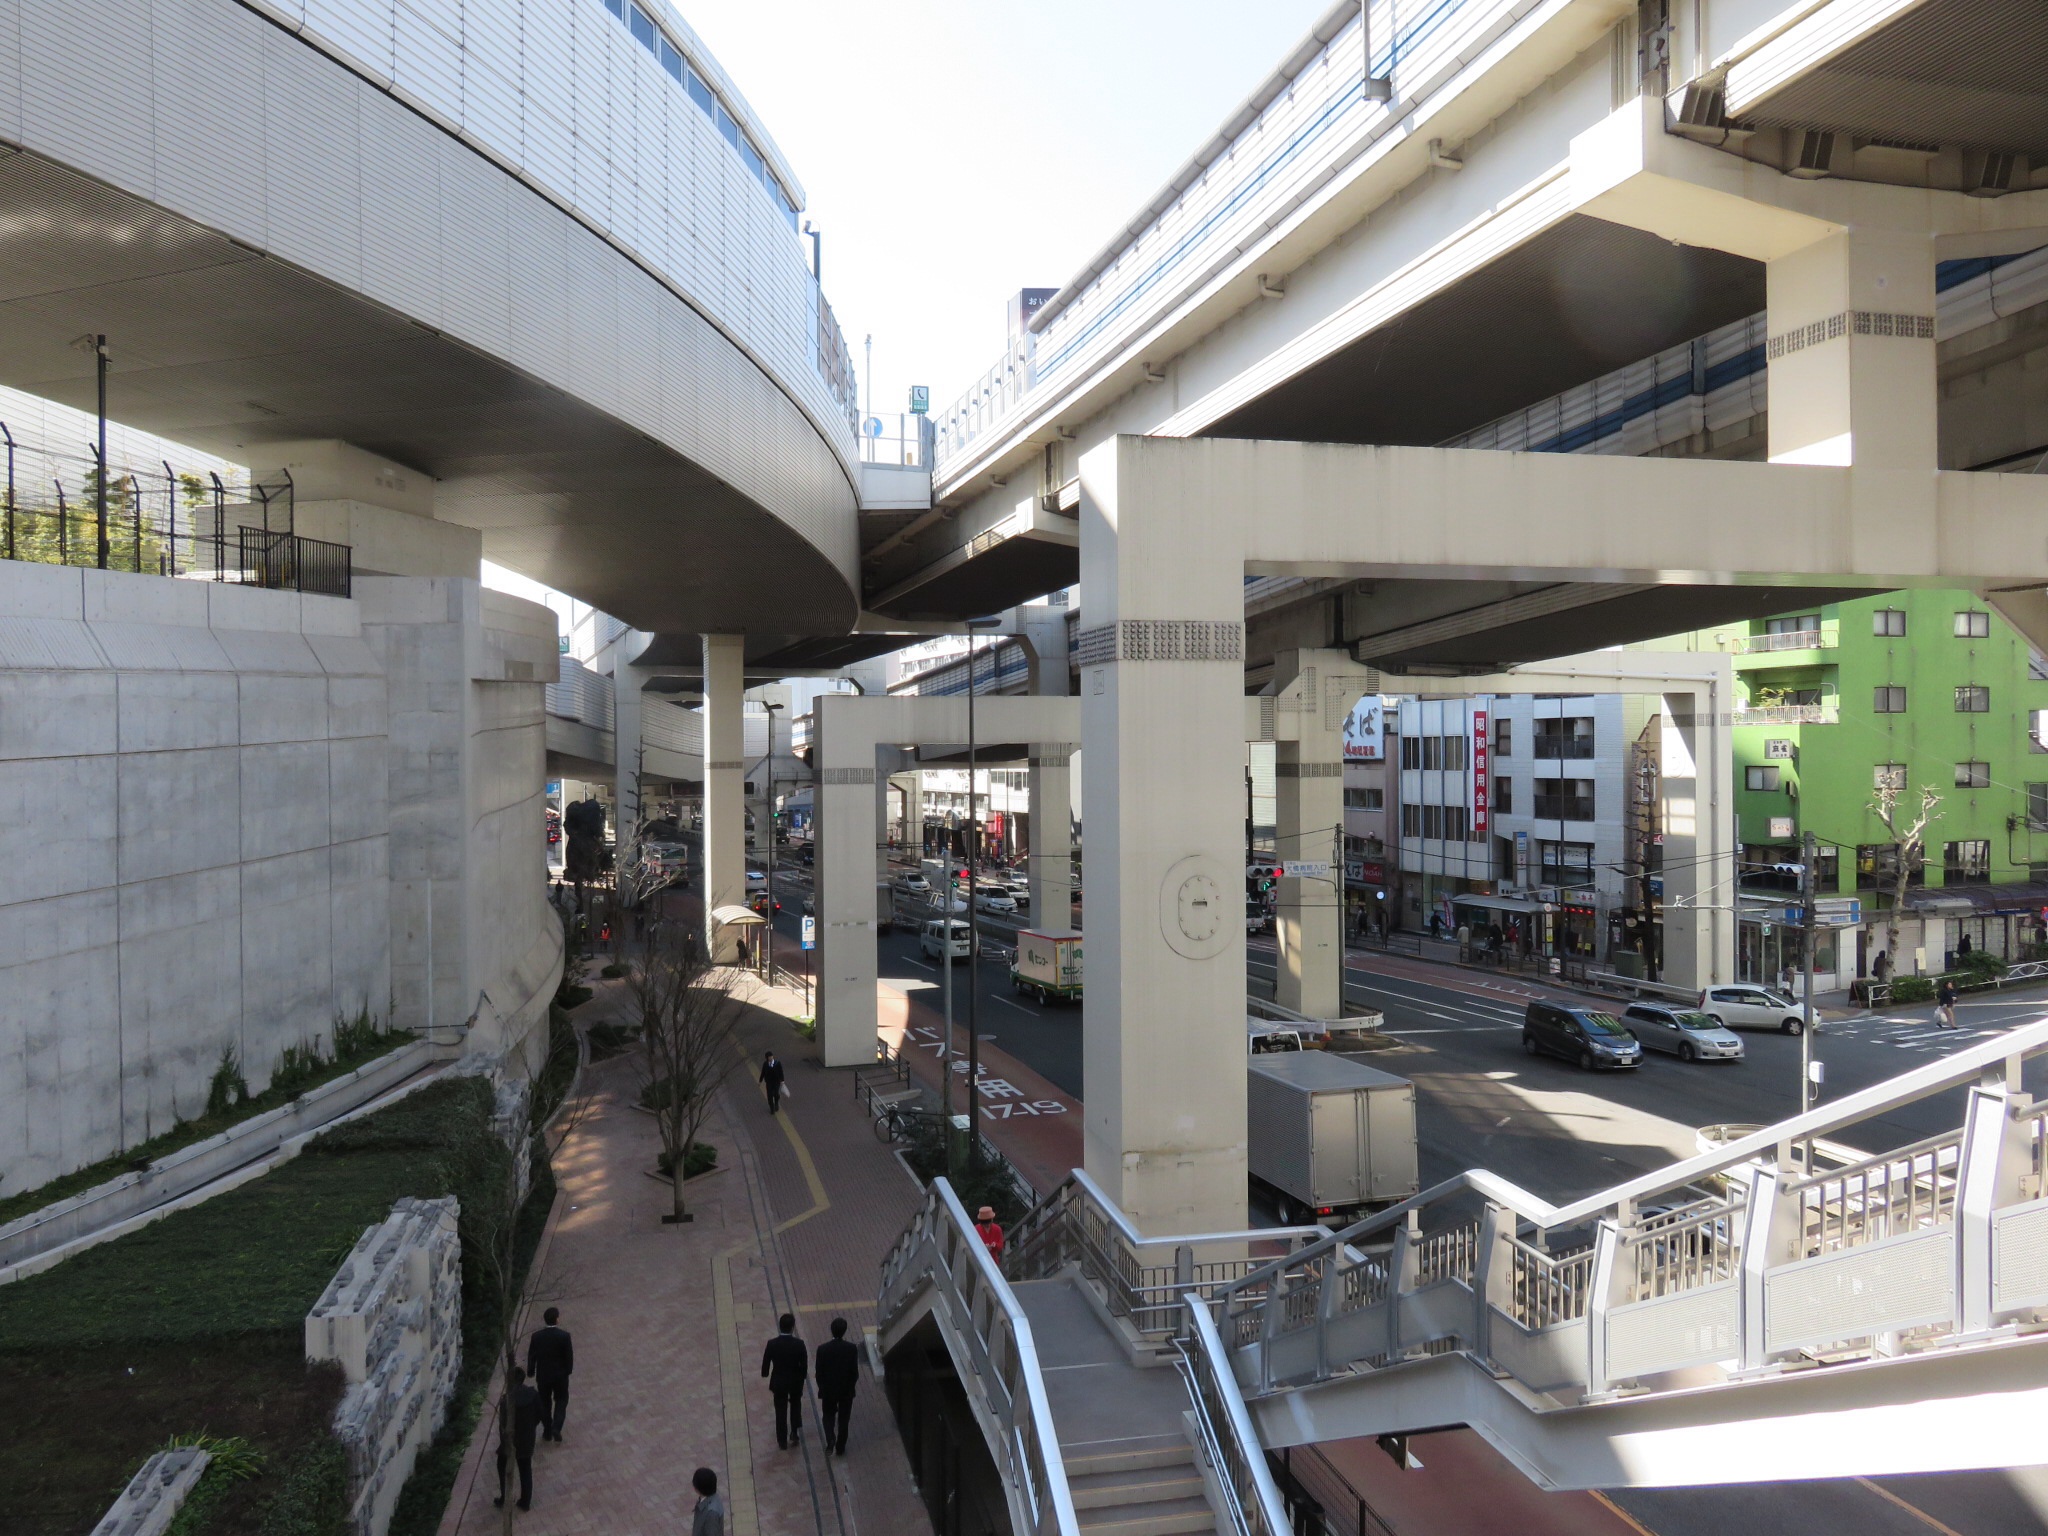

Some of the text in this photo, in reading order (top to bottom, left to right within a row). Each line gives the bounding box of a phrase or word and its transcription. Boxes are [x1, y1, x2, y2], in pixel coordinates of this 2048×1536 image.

[1771, 744, 1788, 753] 麻雀
[1475, 717, 1486, 825] 昭和信用金庫
[804, 919, 815, 932] P
